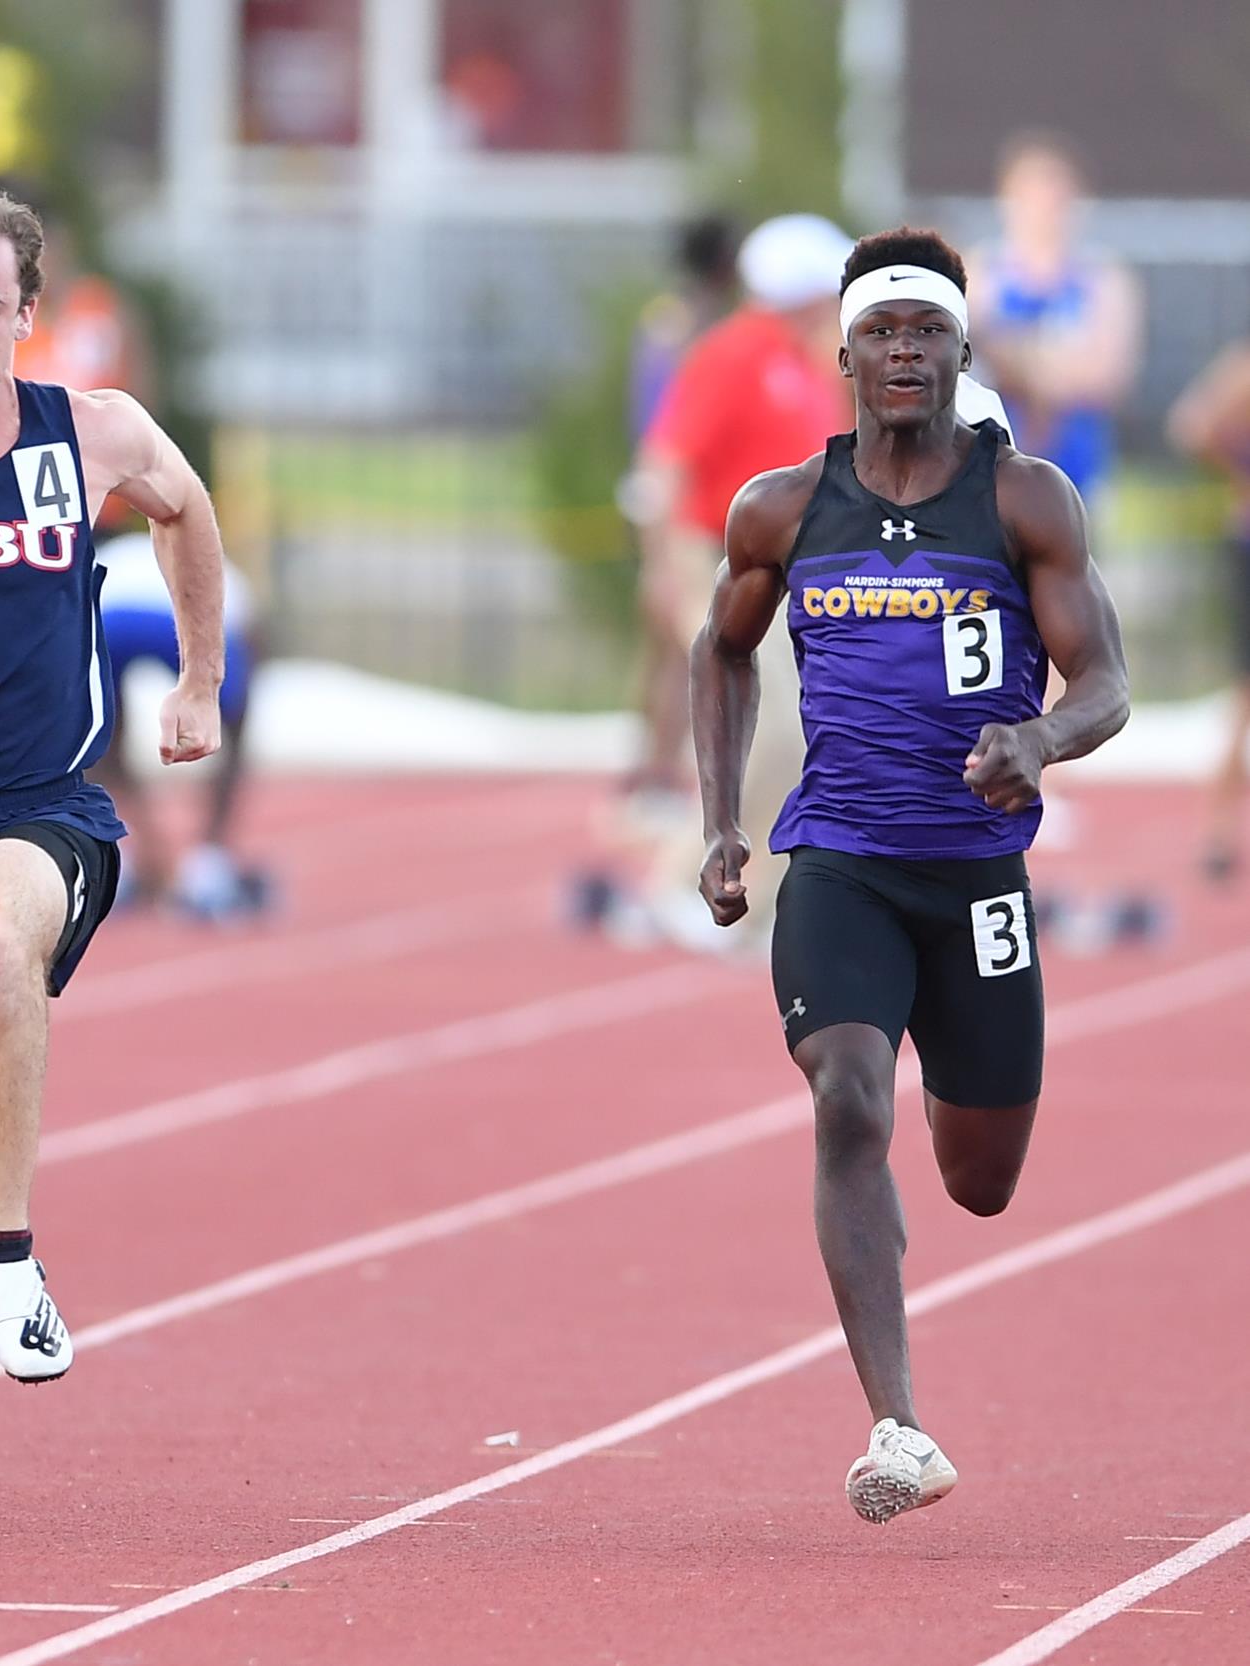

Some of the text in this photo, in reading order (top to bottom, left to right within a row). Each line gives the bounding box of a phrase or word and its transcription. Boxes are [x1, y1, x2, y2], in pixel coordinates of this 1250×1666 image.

[34, 451, 71, 518] 4
[803, 586, 993, 619] COWBOYS
[844, 575, 944, 588] HARDIN-SIMMONS
[957, 617, 991, 688] 3
[986, 901, 1019, 970] 3
